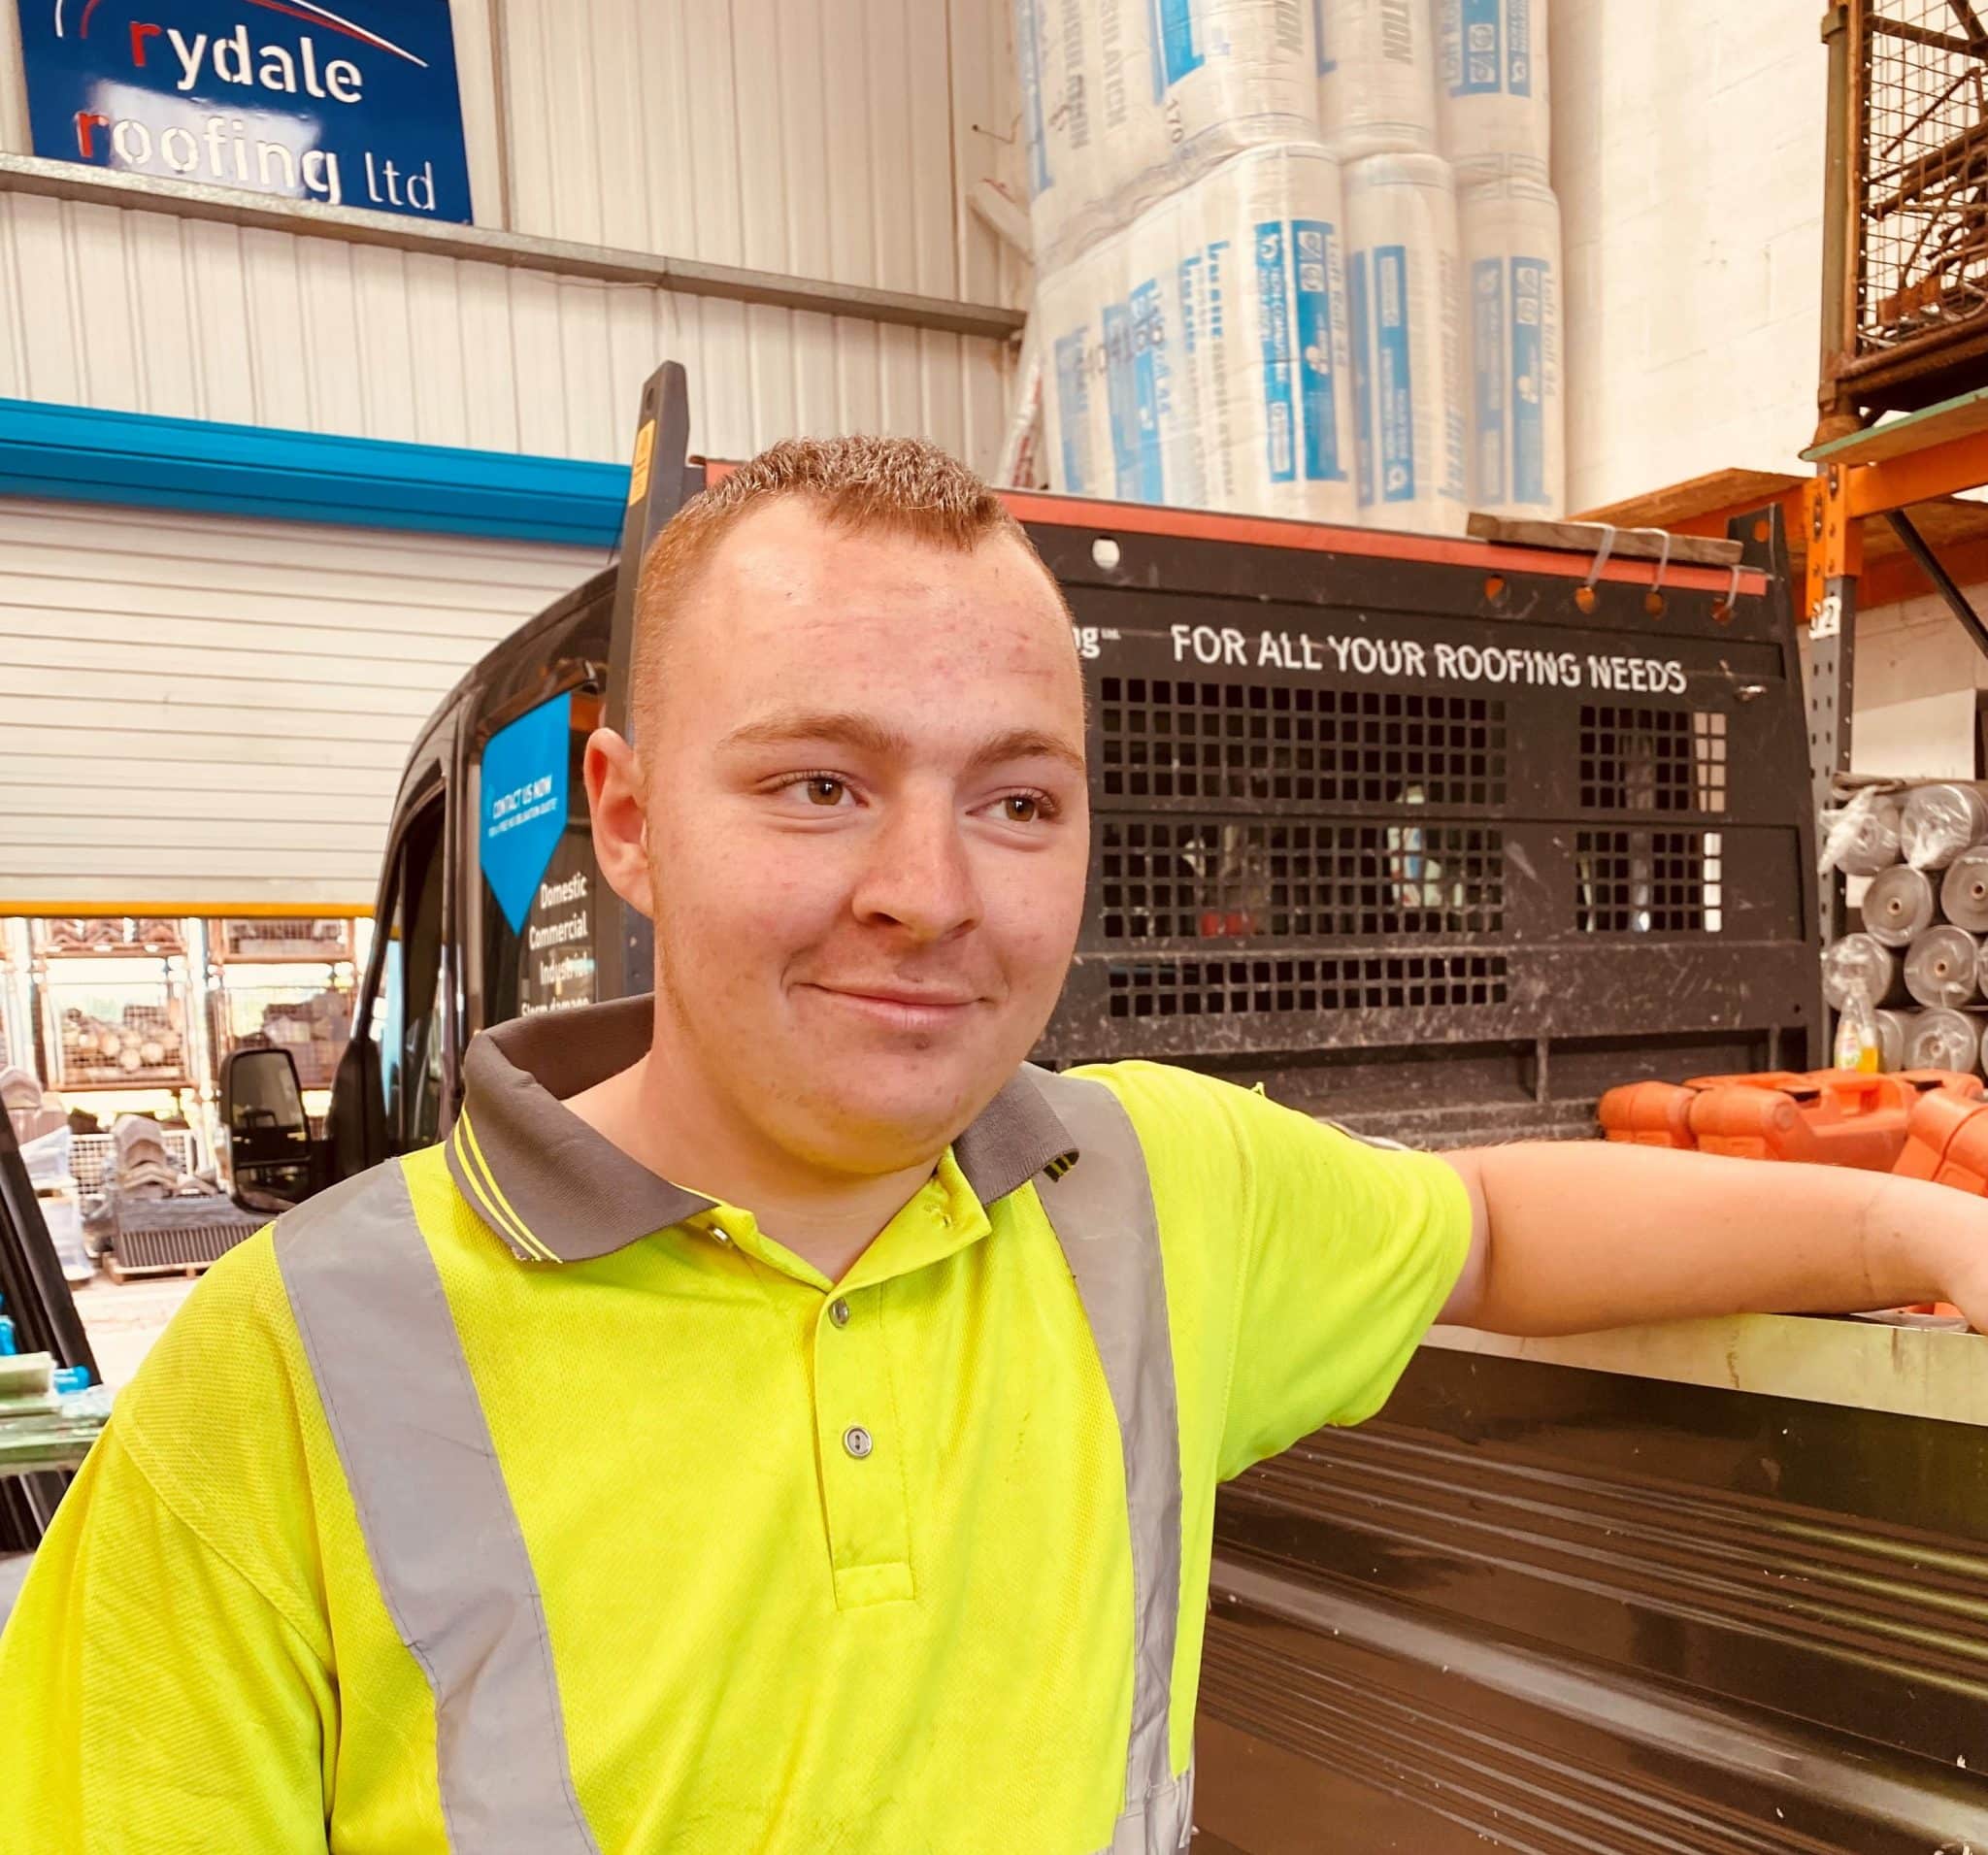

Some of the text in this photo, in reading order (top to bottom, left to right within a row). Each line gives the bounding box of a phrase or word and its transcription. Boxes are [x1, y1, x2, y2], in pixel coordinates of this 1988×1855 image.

[129, 20, 363, 103] rydale
[76, 111, 436, 211] roofing ltd
[1171, 624, 1687, 694] FOR ALL YOUR ROOFING NEEDS
[492, 787, 521, 820] CONTACT
[521, 782, 533, 805] US
[533, 774, 552, 800] NOW
[540, 871, 587, 910] Domestic
[529, 910, 588, 950] Commercial
